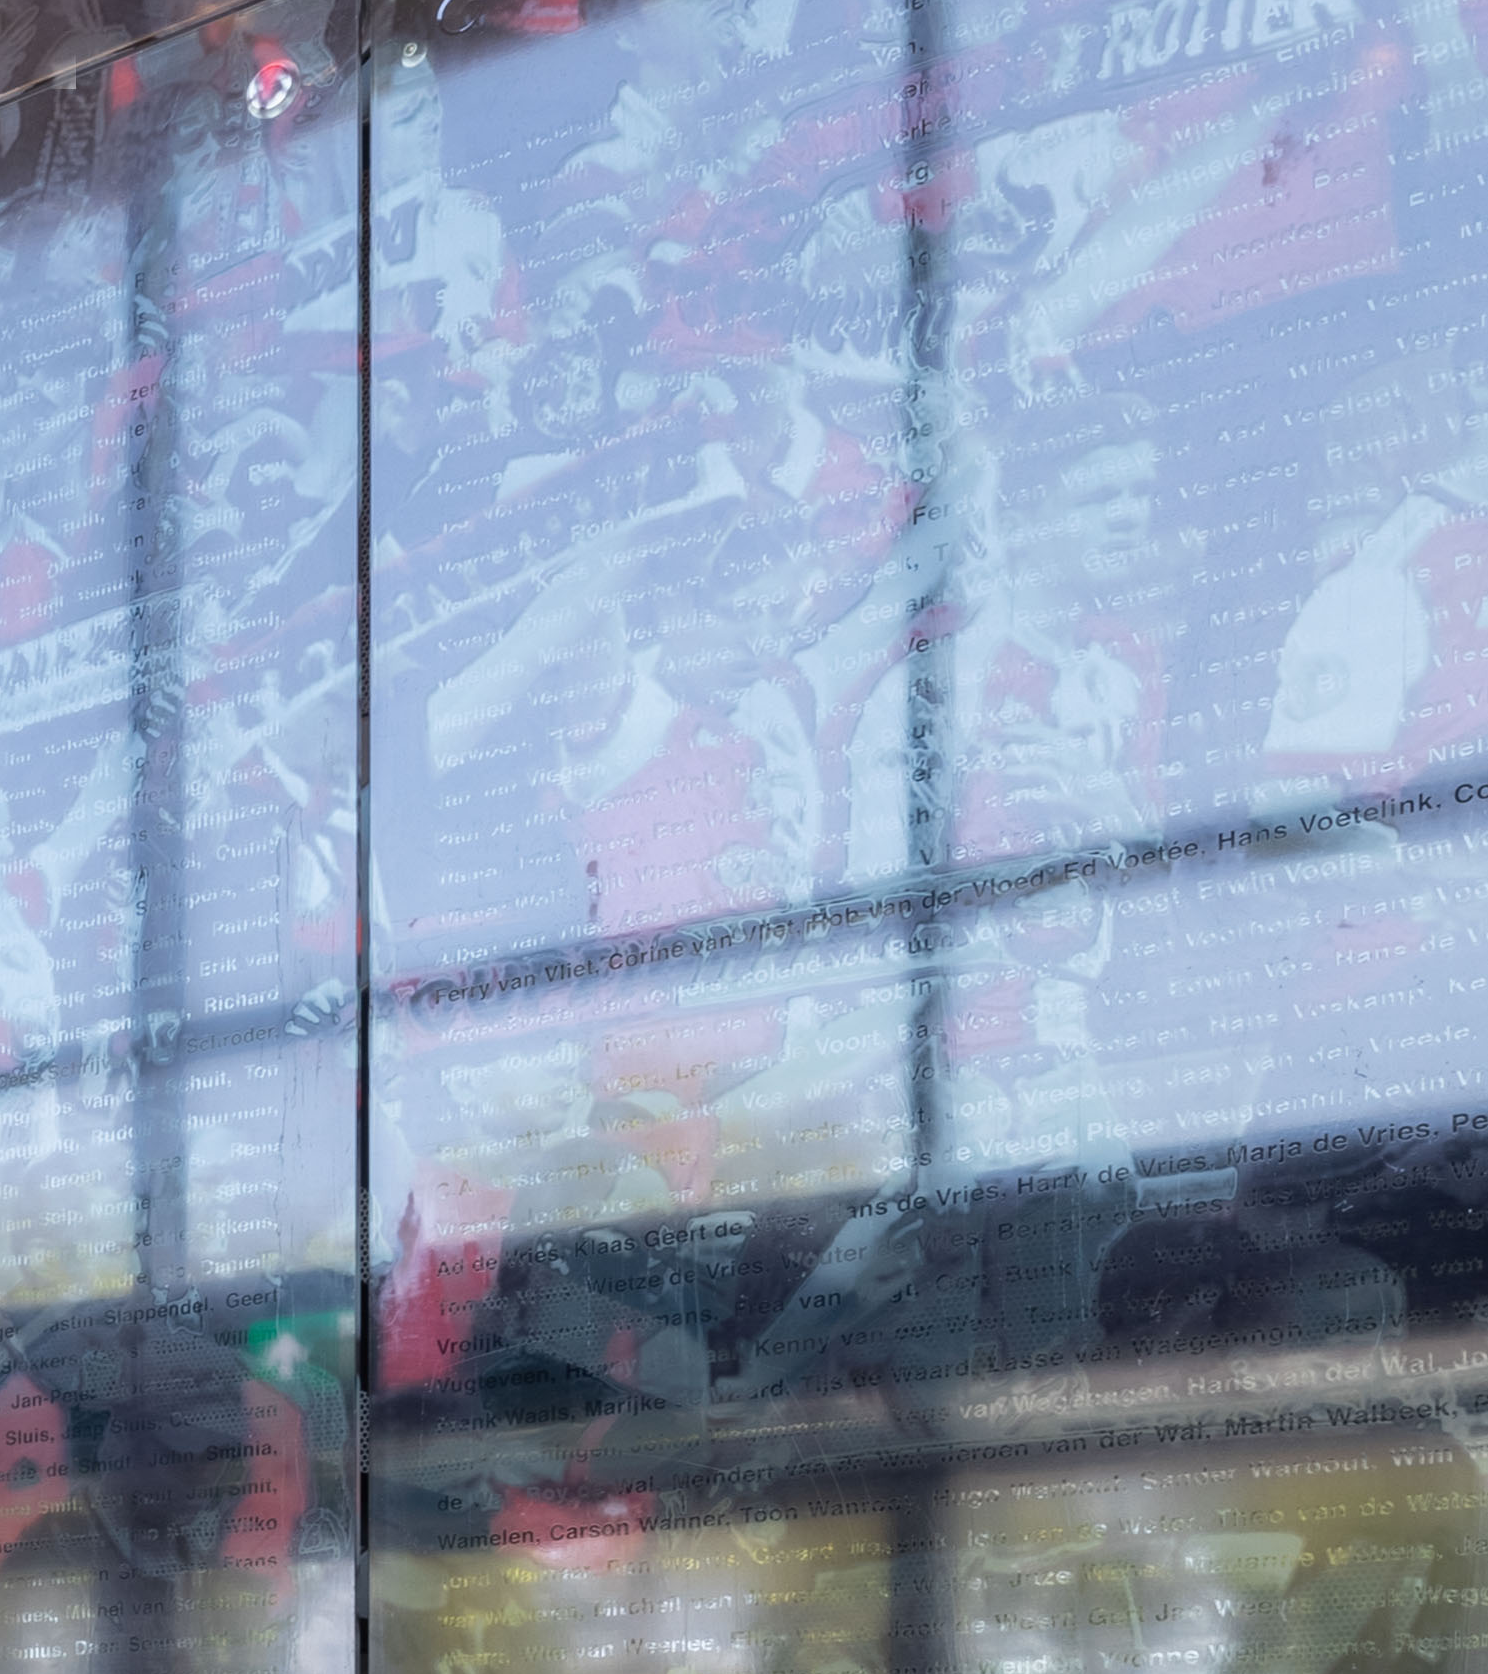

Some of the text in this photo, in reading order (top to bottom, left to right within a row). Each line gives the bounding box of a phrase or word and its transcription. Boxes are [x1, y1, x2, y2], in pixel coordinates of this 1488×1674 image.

[1108, 838, 1206, 872] Voetée,
[1217, 823, 1288, 853] Hans
[435, 979, 490, 1004] Ferry
[498, 966, 535, 992] van
[607, 938, 684, 971] Corine
[691, 931, 733, 957] van
[574, 1236, 636, 1259] Klaas
[643, 1225, 706, 1248] Geert
[714, 1219, 744, 1238] de
[897, 1191, 928, 1212] de
[1017, 1170, 1088, 1200] Harry
[1097, 1165, 1130, 1184] de
[1227, 1141, 1302, 1167] Marja
[1313, 1132, 1348, 1153] de
[1357, 1119, 1439, 1145] Vries,
[668, 1267, 696, 1286] de
[754, 1336, 831, 1360] Kenny
[584, 1393, 667, 1419] Marijke
[1041, 1436, 1088, 1456] van
[1225, 1414, 1313, 1438] Martin
[549, 1513, 630, 1542] Carson
[738, 1505, 798, 1523] Toon
